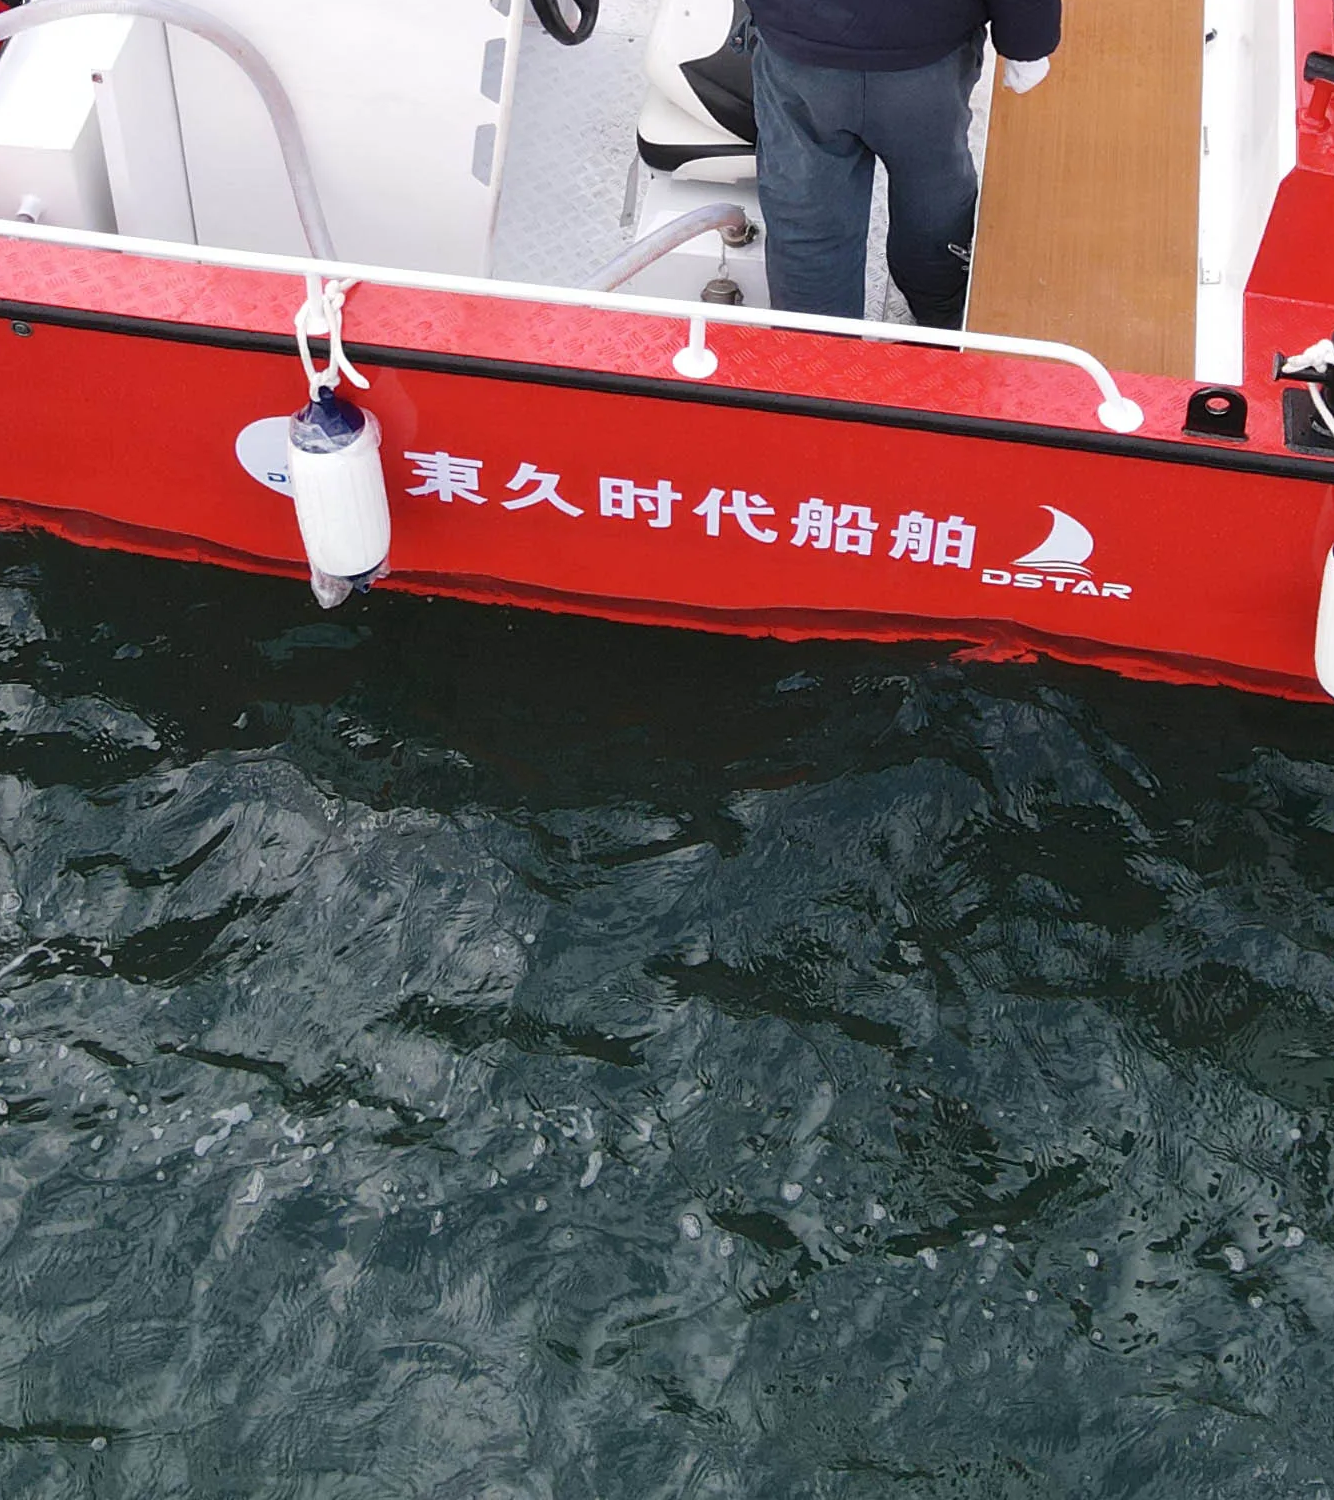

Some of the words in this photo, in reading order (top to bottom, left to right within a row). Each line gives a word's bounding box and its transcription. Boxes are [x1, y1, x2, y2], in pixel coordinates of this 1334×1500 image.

[403, 451, 977, 569] 東久时代船舶
[980, 568, 1133, 600] DSTAR
